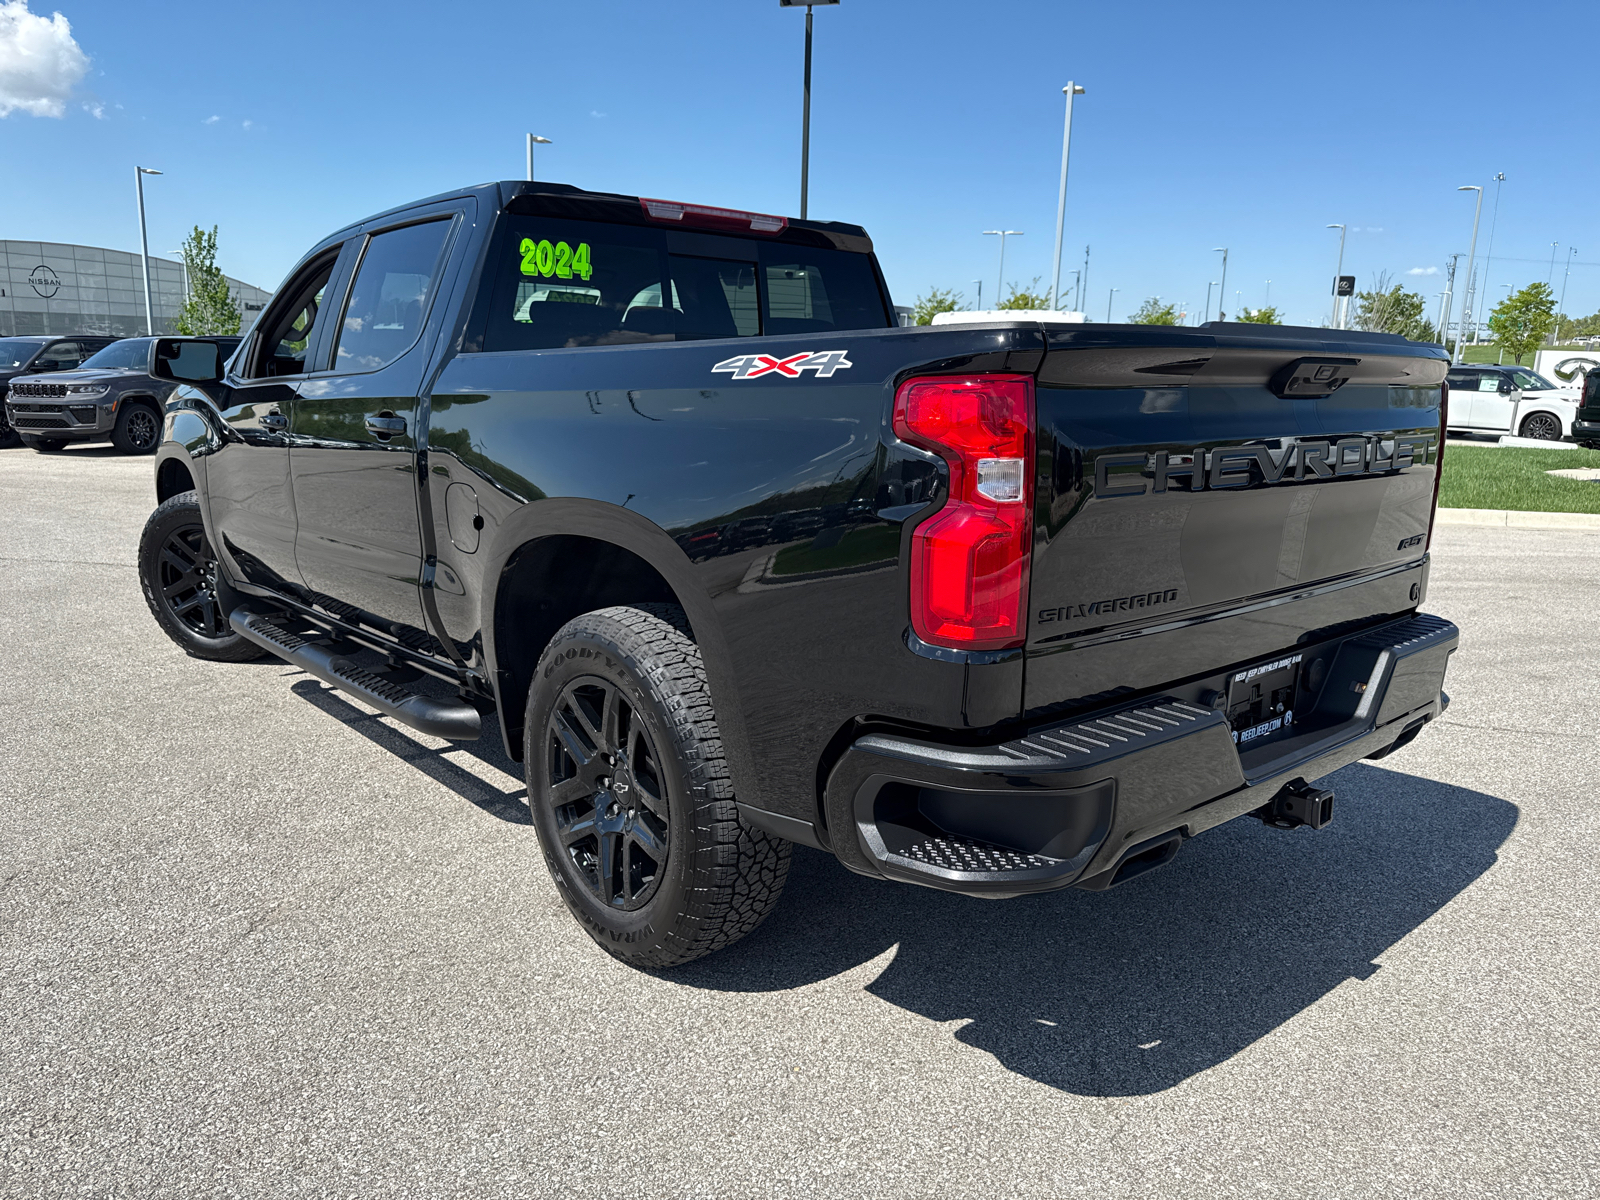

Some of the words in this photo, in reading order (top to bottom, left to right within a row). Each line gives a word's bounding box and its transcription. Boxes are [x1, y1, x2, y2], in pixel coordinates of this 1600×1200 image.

[519, 238, 593, 281] 2024
[28, 277, 61, 286] NISSAN
[1093, 434, 1436, 499] CHEVROLET
[1038, 588, 1178, 624] SILVERADO
[1240, 718, 1282, 742] REEDJEEP.COM
